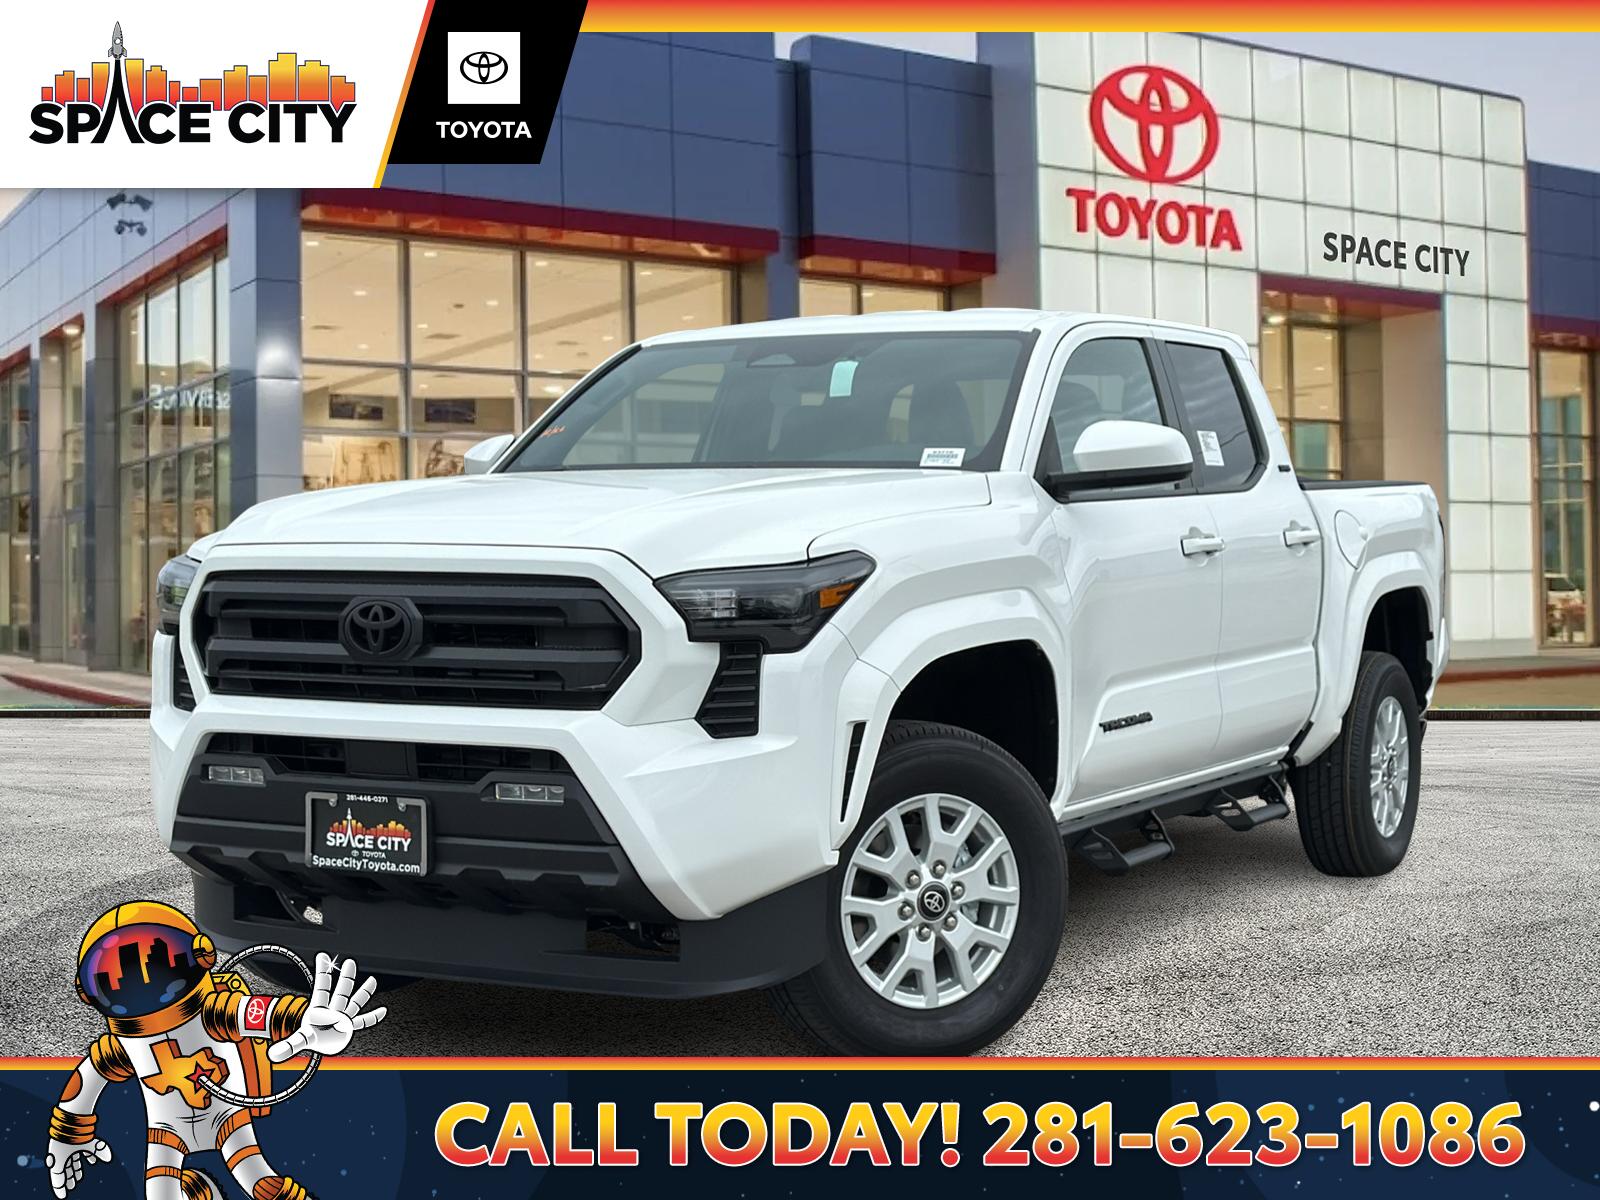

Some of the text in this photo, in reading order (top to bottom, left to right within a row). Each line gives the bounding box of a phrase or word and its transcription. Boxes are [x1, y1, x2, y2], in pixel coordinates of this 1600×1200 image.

[1065, 187, 1243, 252] TOYOTA
[1323, 231, 1470, 277] SPACE CITY
[326, 828, 412, 852] SPACE CITY
[312, 855, 420, 873] SpaceCityToyota.com
[362, 851, 387, 859] TOYOTA
